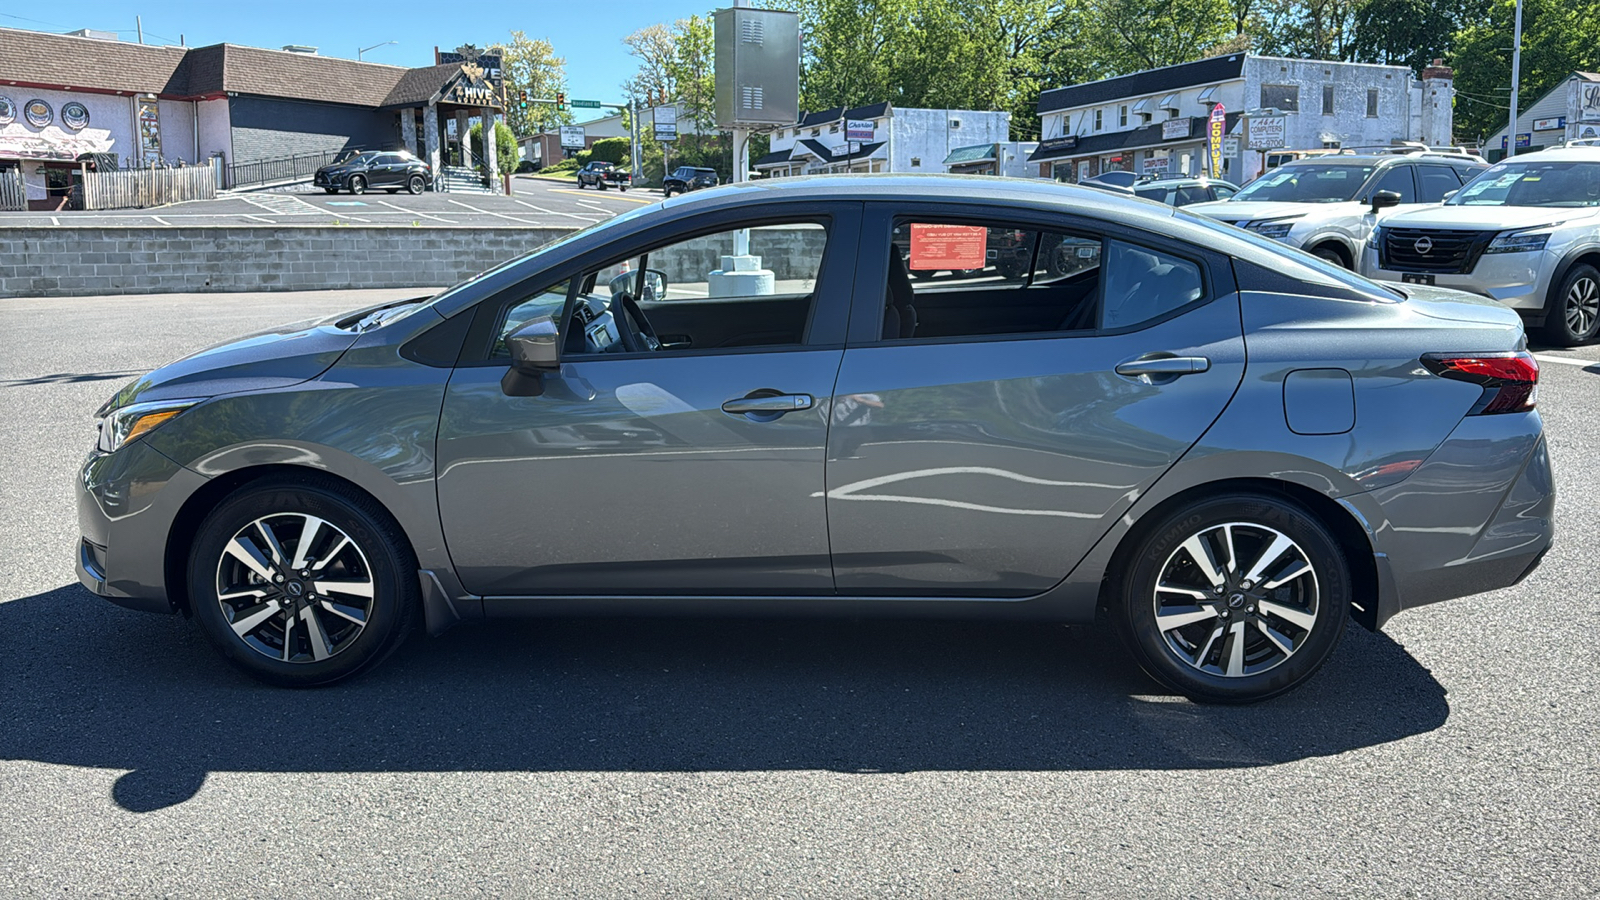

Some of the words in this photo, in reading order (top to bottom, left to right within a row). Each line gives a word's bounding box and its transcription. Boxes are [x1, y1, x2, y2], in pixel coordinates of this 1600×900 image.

[465, 87, 492, 100] HIVE
[1258, 118, 1276, 126] A&A
[1250, 125, 1283, 134] COMPUTERS
[1211, 122, 1222, 179] COMPUTER
[1249, 140, 1284, 148] 942-9700
[1148, 515, 1202, 561] KUMHO
[1323, 558, 1340, 618] SOLUS
